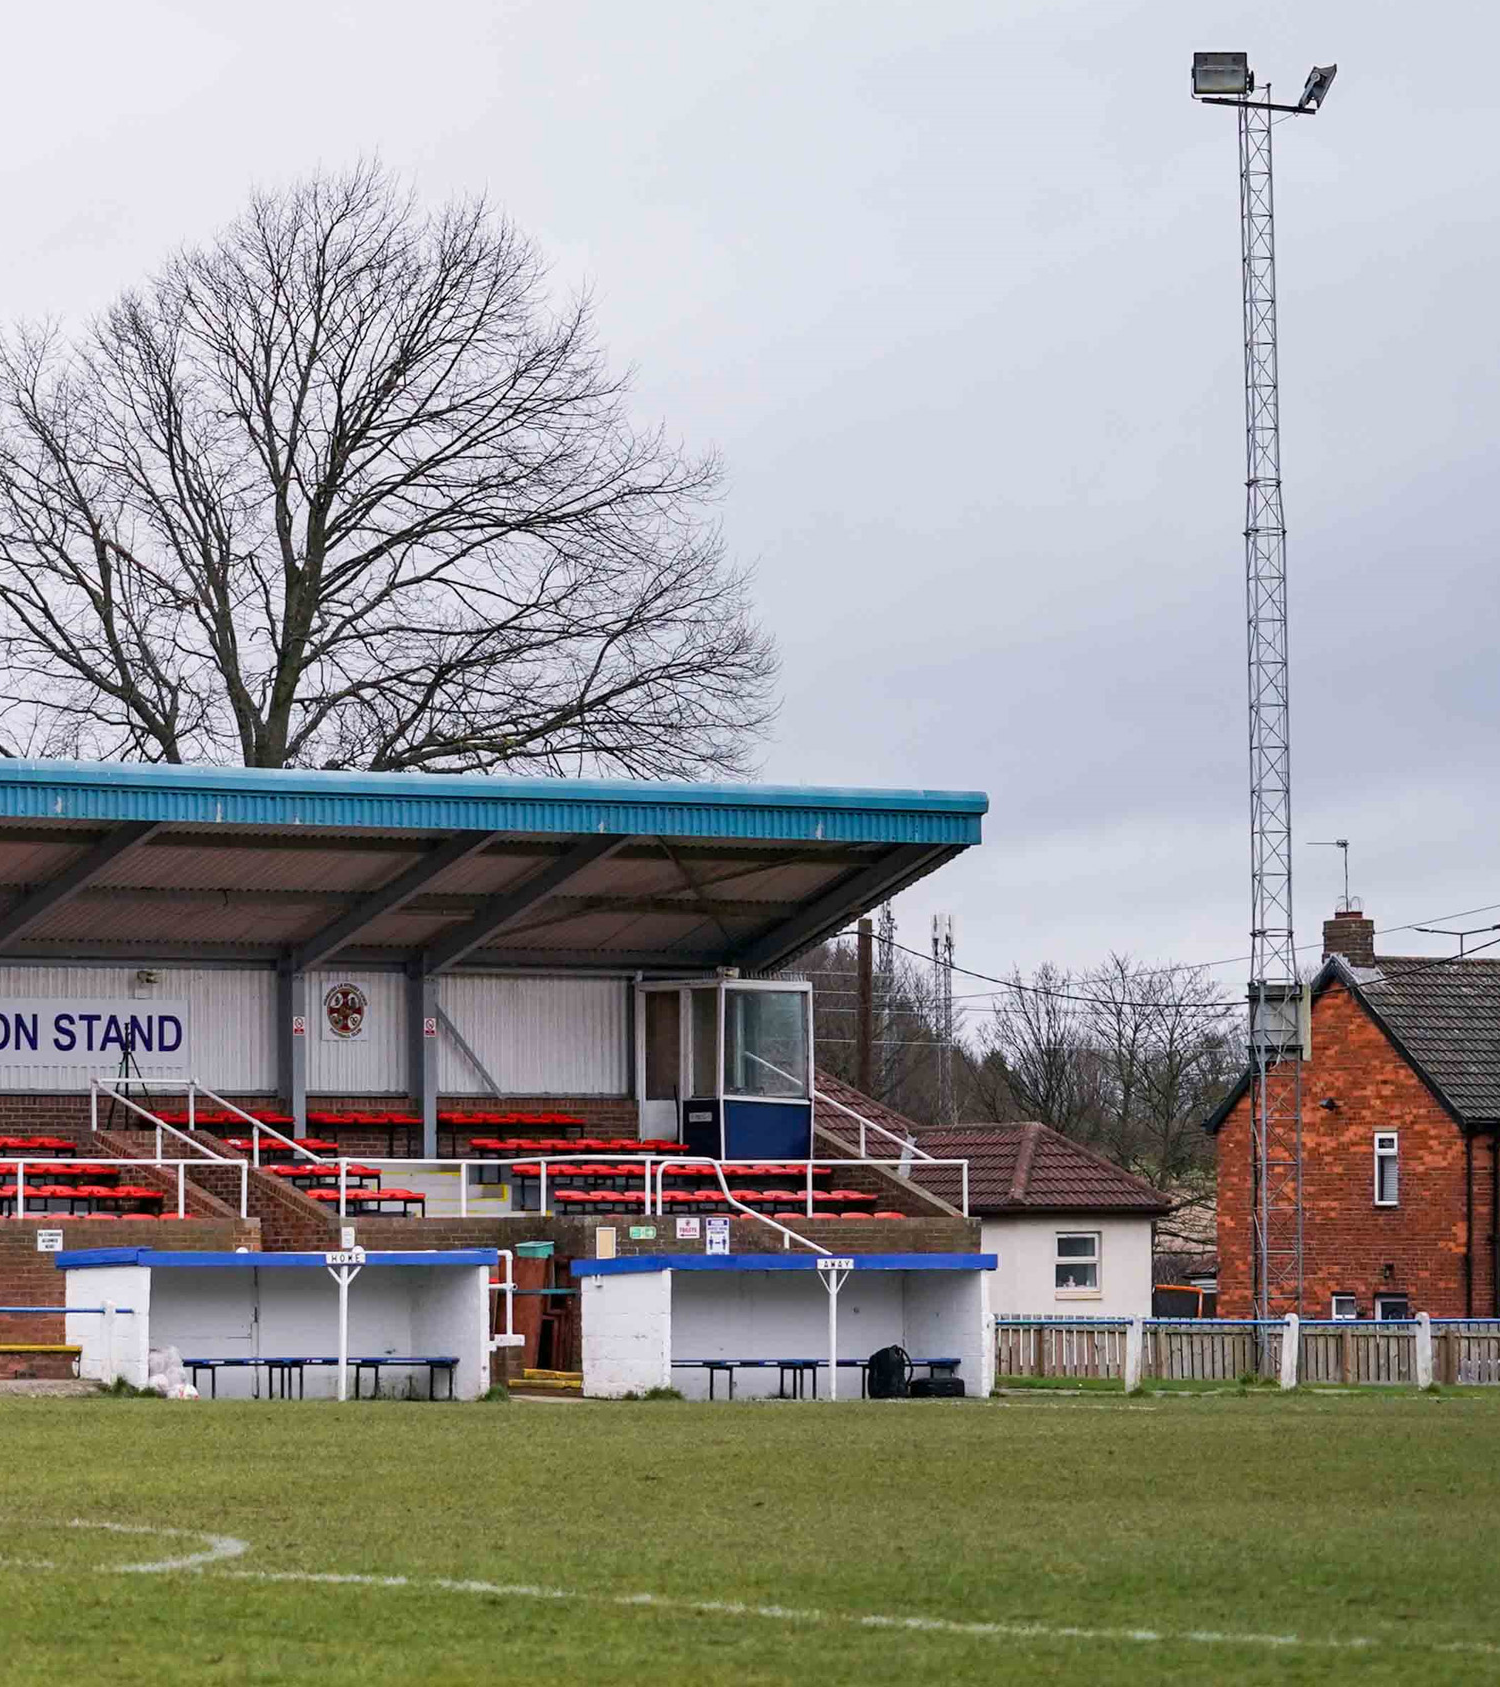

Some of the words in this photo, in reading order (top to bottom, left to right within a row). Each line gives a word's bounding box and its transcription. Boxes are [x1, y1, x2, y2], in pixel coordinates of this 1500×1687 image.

[53, 1013, 182, 1052] STAND
[331, 1253, 360, 1263] HOME
[823, 1260, 850, 1268] AWAY
